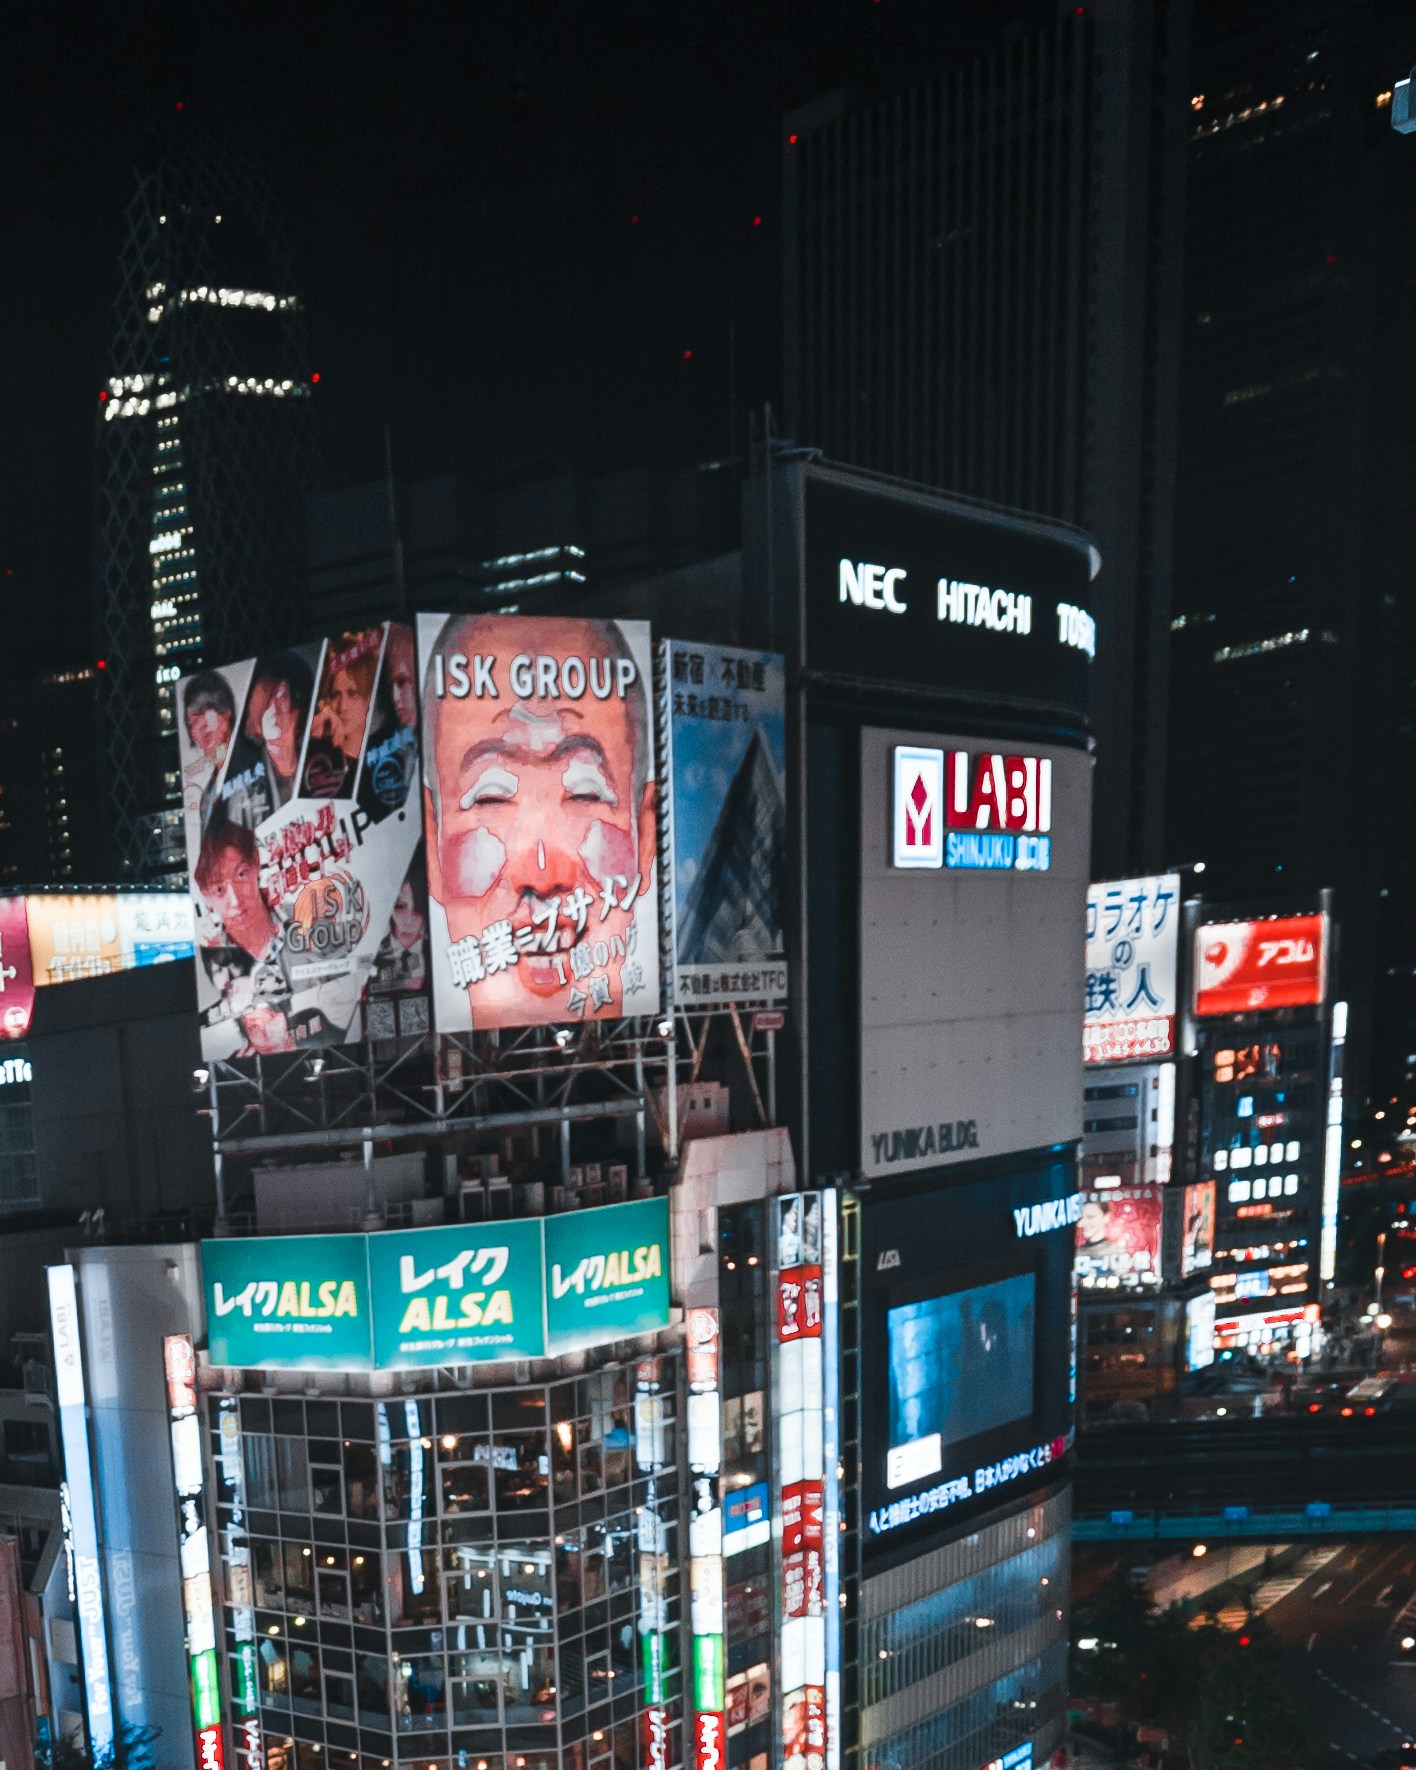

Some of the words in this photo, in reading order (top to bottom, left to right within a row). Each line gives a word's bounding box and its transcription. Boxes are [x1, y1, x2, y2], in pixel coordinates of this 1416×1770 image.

[840, 559, 907, 614] NEC
[937, 578, 1032, 635] HITACHI
[435, 653, 497, 700] ISK
[509, 653, 637, 700] GROUP
[947, 751, 1052, 833] LABI
[947, 833, 1015, 868] SHINJUKU
[309, 879, 364, 918] ISK
[286, 917, 363, 953] Group
[1258, 937, 1314, 967] アコム
[1085, 967, 1158, 1012] 鉄人
[400, 1245, 510, 1295] レイク
[552, 1243, 663, 1301] レイクALSA
[213, 1280, 358, 1318] レイクALSA
[398, 1289, 514, 1334] ALSA
